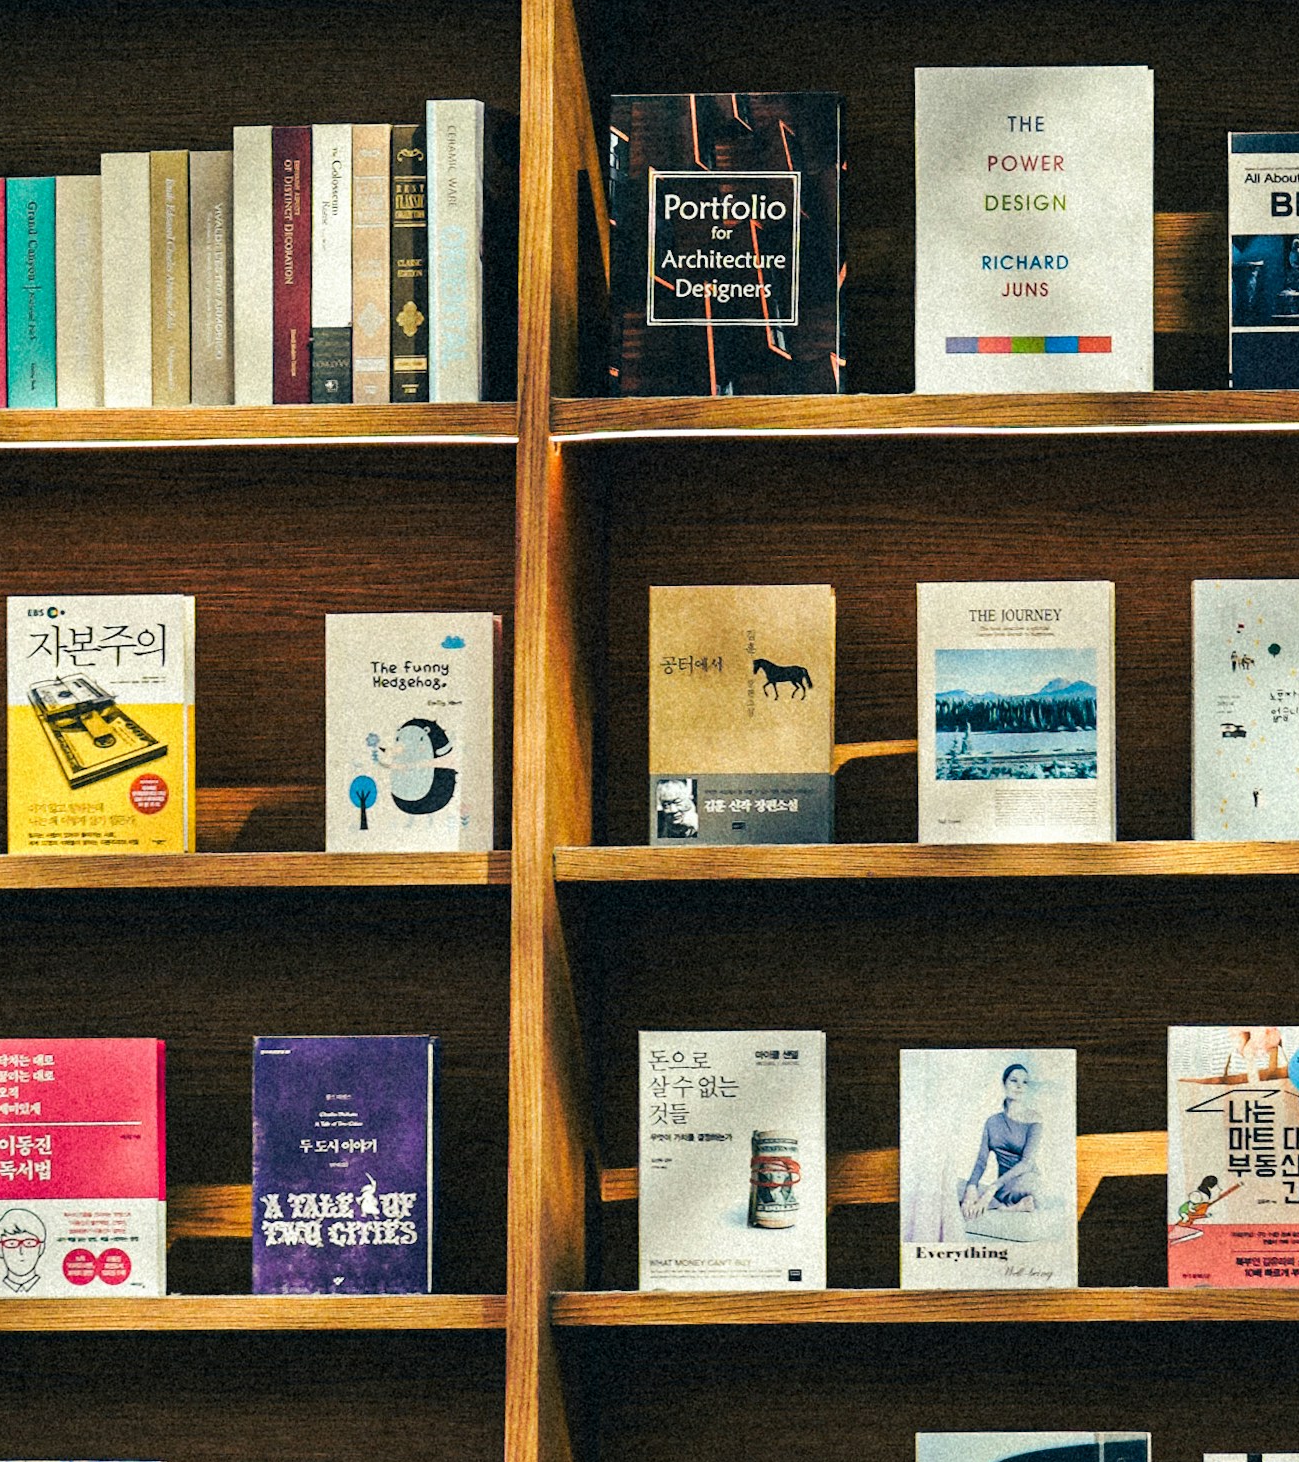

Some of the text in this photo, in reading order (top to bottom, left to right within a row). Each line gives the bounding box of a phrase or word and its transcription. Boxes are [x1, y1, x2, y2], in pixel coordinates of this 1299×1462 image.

[1006, 115, 1043, 132] THE
[986, 154, 1063, 172] POWER
[1245, 173, 1261, 184] All
[663, 194, 786, 224] Portfolio
[984, 194, 1066, 212] DESIGN
[710, 226, 733, 240] for
[663, 251, 786, 271] Architecture
[982, 254, 1069, 271] RICHARD
[675, 280, 772, 301] Designers
[1002, 282, 1049, 298] JUNS
[969, 608, 1062, 623] THE JOURNEY
[27, 623, 168, 668] 자본주의
[371, 660, 450, 676] The Funny
[373, 676, 447, 691] Hedgehog.
[649, 1049, 711, 1071] 돈으로
[651, 1075, 740, 1099] 살 수 없는
[652, 1103, 690, 1126] 것들
[1228, 1101, 1275, 1124] 나는
[1229, 1127, 1274, 1151] 마트
[916, 1246, 1008, 1261] Everything
